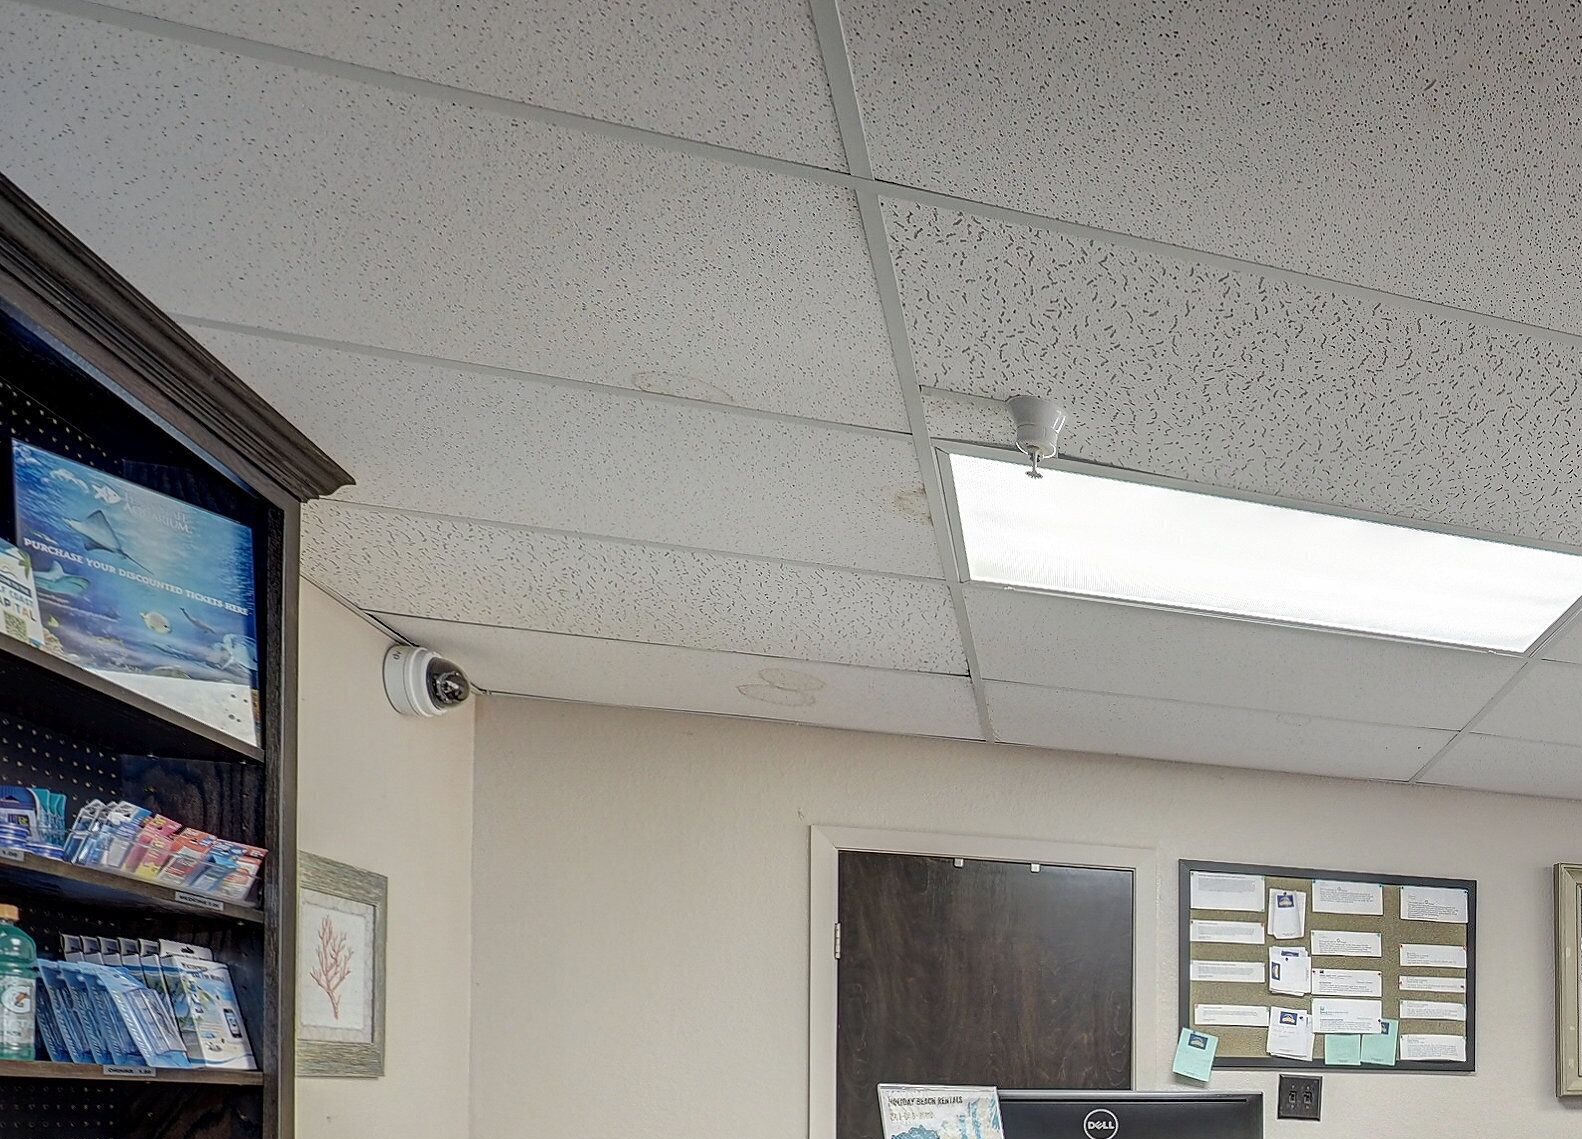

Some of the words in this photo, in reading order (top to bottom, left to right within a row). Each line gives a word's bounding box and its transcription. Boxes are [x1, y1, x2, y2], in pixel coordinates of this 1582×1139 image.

[23, 537, 84, 564] PURCHASE
[85, 558, 117, 575] YOUR
[118, 568, 183, 595] DISCOUNTED
[185, 589, 224, 608] TICKETS
[1087, 1120, 1116, 1130] DELL
